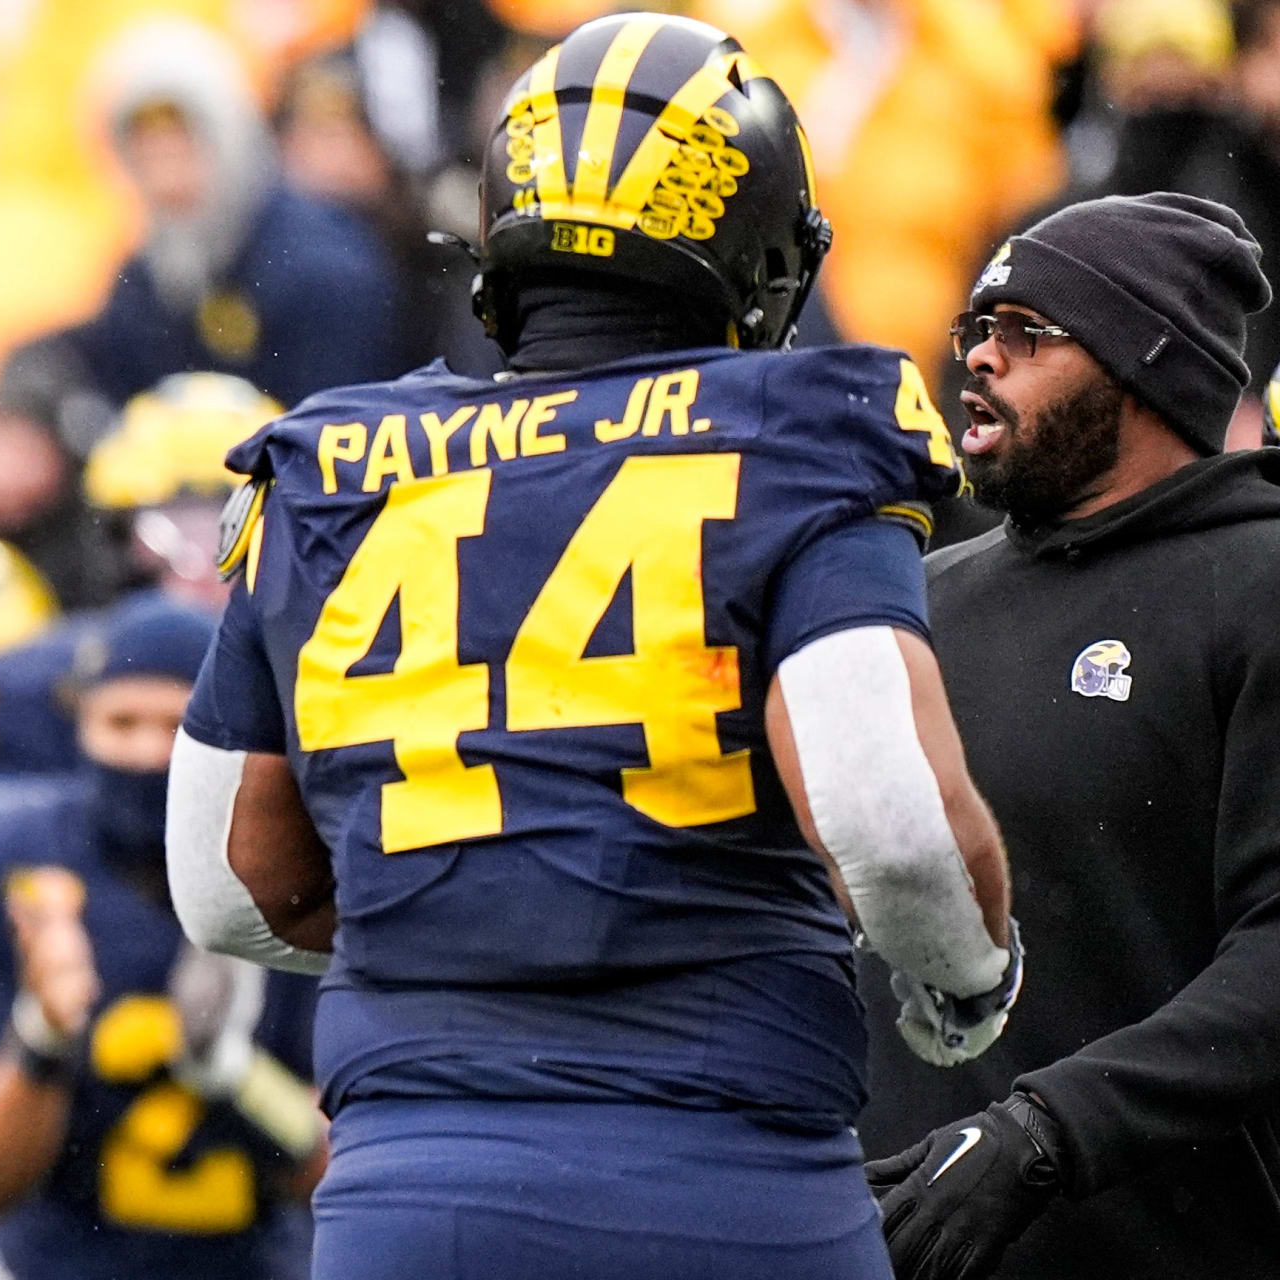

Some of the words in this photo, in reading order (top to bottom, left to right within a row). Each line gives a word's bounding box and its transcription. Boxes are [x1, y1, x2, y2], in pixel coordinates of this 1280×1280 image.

[317, 391, 577, 494] PAYNE
[595, 369, 711, 444] JR.
[295, 453, 756, 854] 44
[90, 993, 257, 1235] 2
